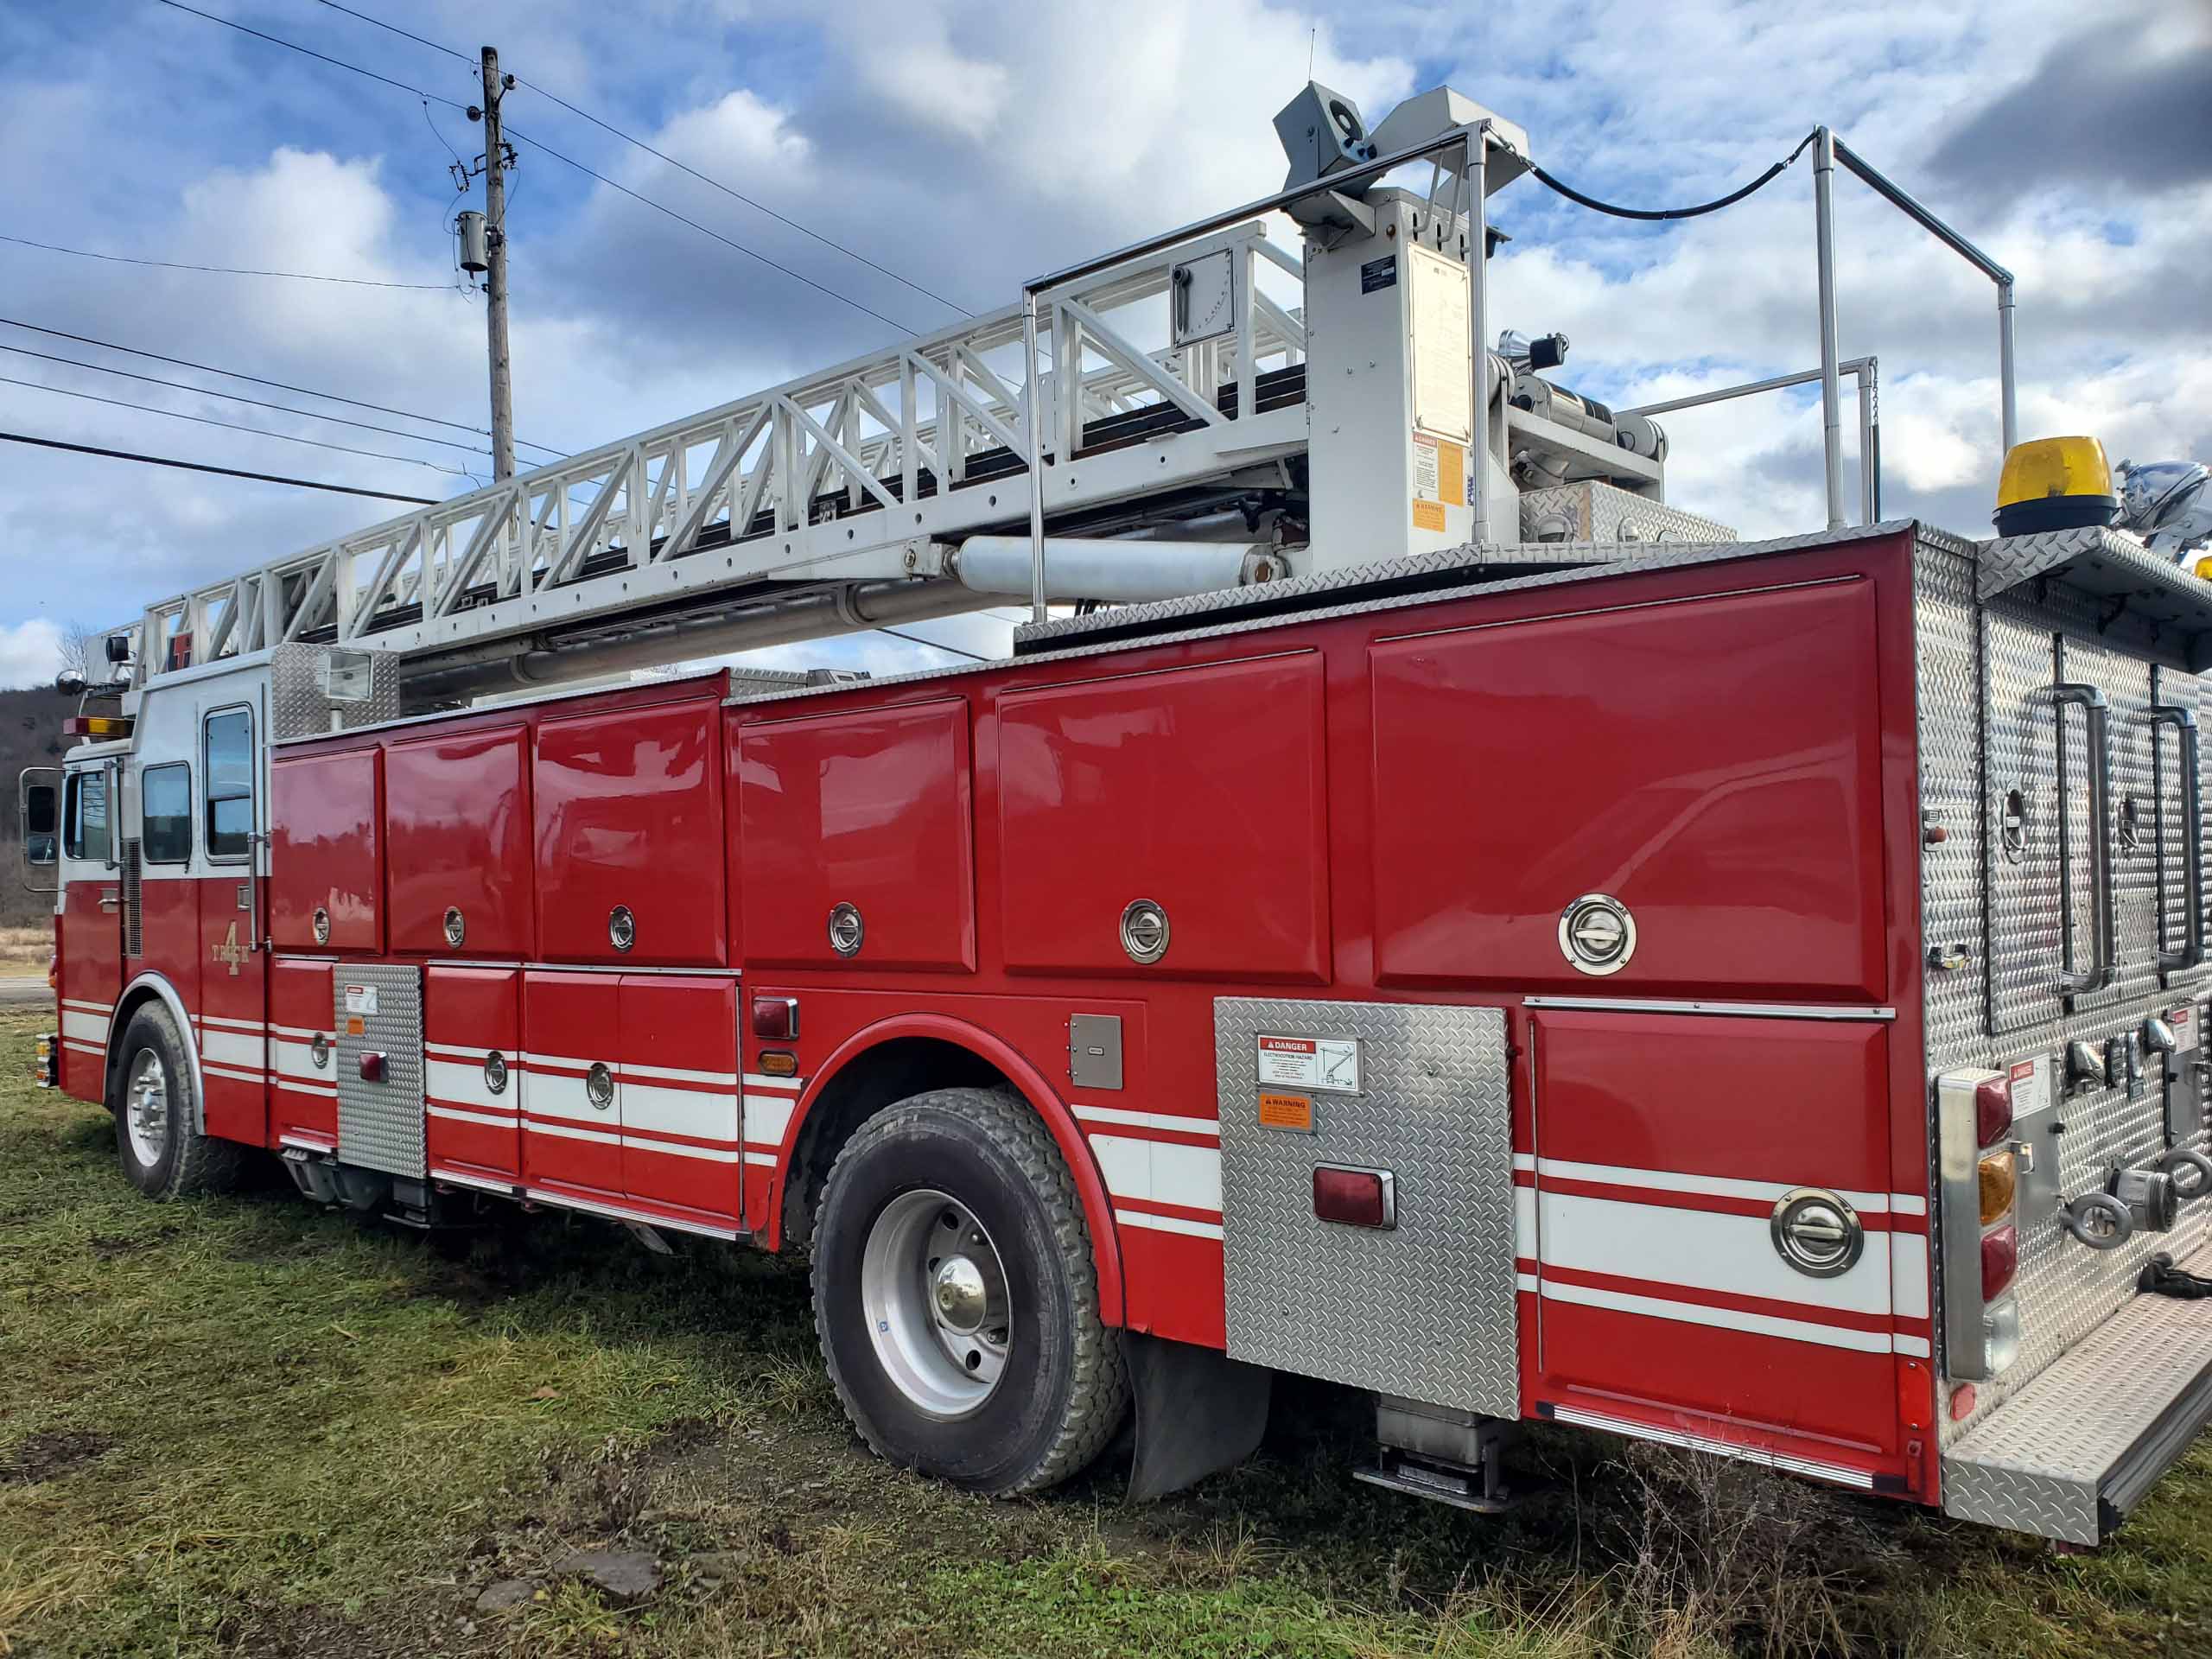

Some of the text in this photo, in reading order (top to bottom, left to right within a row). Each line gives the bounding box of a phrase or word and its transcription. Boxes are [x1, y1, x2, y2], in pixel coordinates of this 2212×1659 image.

[225, 921, 239, 976] 4
[1274, 1041, 1307, 1052] DANGER
[1272, 1098, 1306, 1109] WARNING
